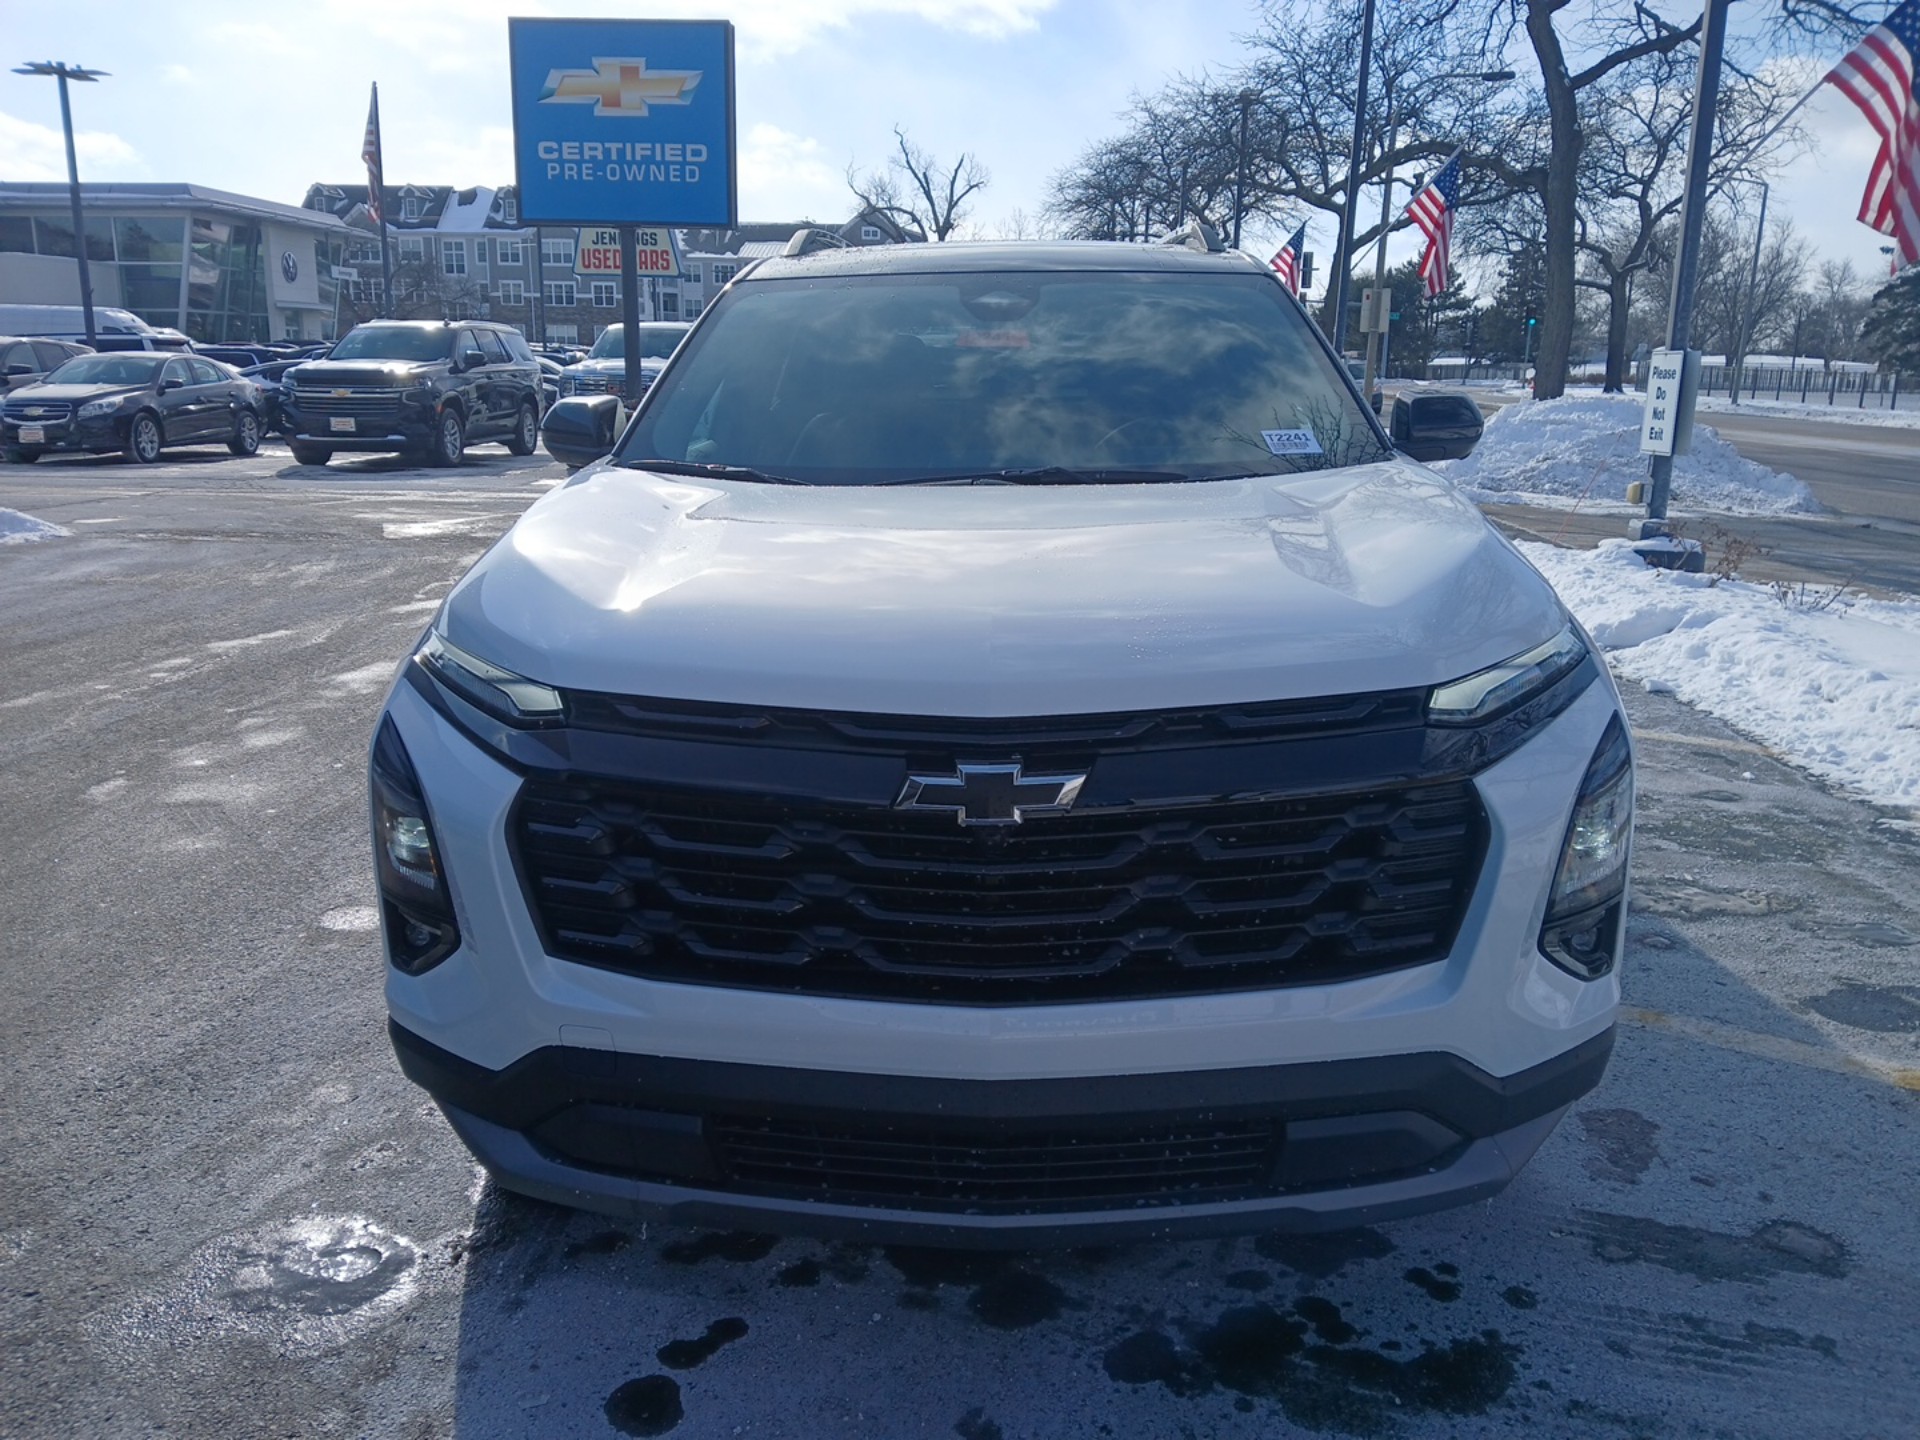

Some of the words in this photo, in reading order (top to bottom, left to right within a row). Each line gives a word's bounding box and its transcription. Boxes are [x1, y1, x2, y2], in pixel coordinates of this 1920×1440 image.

[537, 141, 708, 162] CERTIFIED
[547, 162, 700, 182] PRE-OWNED
[592, 231, 658, 246] JENGS
[581, 248, 622, 270] USED
[635, 249, 670, 271] ARS
[1652, 366, 1677, 380] Please
[1656, 386, 1667, 400] Do
[1652, 407, 1665, 420] Not
[1648, 426, 1664, 441] Exit
